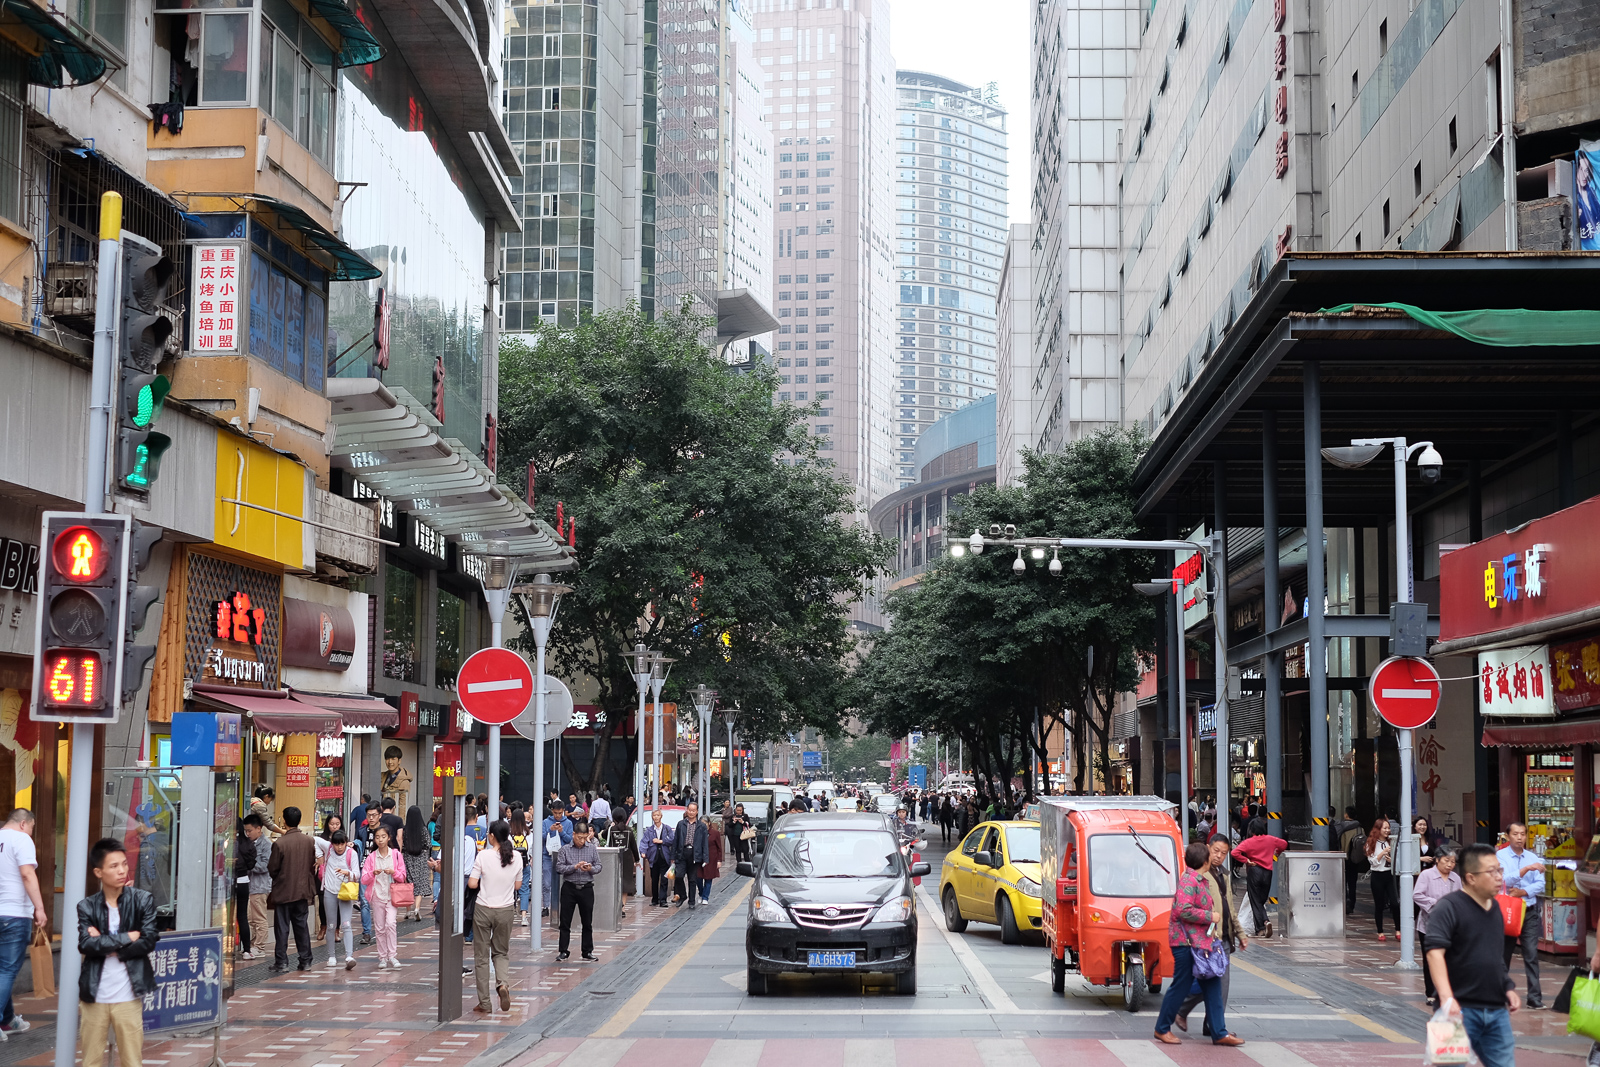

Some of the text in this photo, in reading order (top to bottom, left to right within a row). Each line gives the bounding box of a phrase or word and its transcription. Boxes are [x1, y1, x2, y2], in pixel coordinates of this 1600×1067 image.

[199, 249, 216, 348] 重庆烤鱼培训
[218, 249, 236, 348] 重庆小面加盟
[251, 263, 322, 345] 小吃培训
[0, 538, 40, 595] BK
[1484, 545, 1542, 608] 电玩城
[50, 658, 94, 702] 61
[288, 756, 309, 766] 招聘
